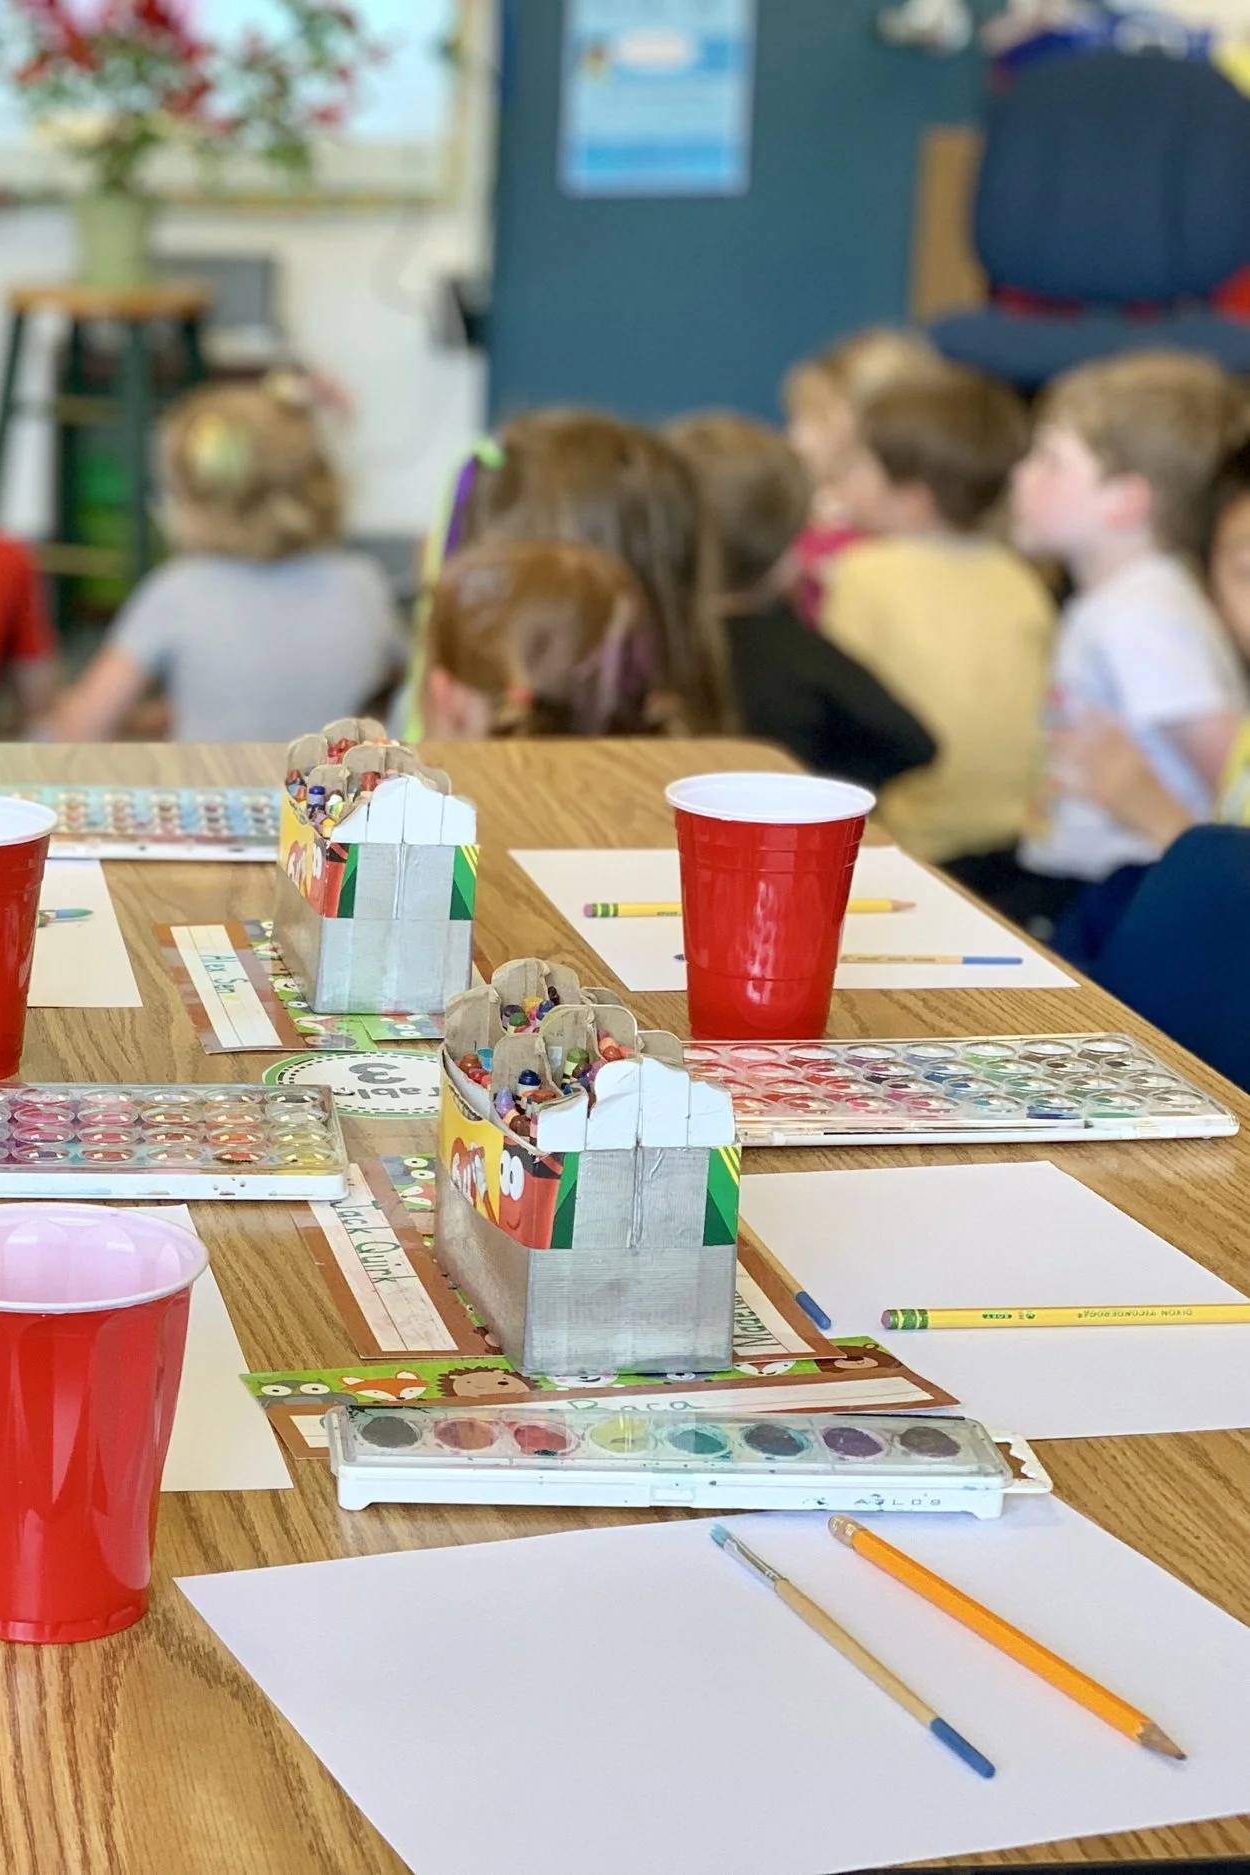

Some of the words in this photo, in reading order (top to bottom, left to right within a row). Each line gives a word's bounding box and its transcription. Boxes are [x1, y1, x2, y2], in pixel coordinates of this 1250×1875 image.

[348, 1062, 407, 1085] 3
[330, 1200, 392, 1235] Jack
[355, 1240, 417, 1284] Quirk
